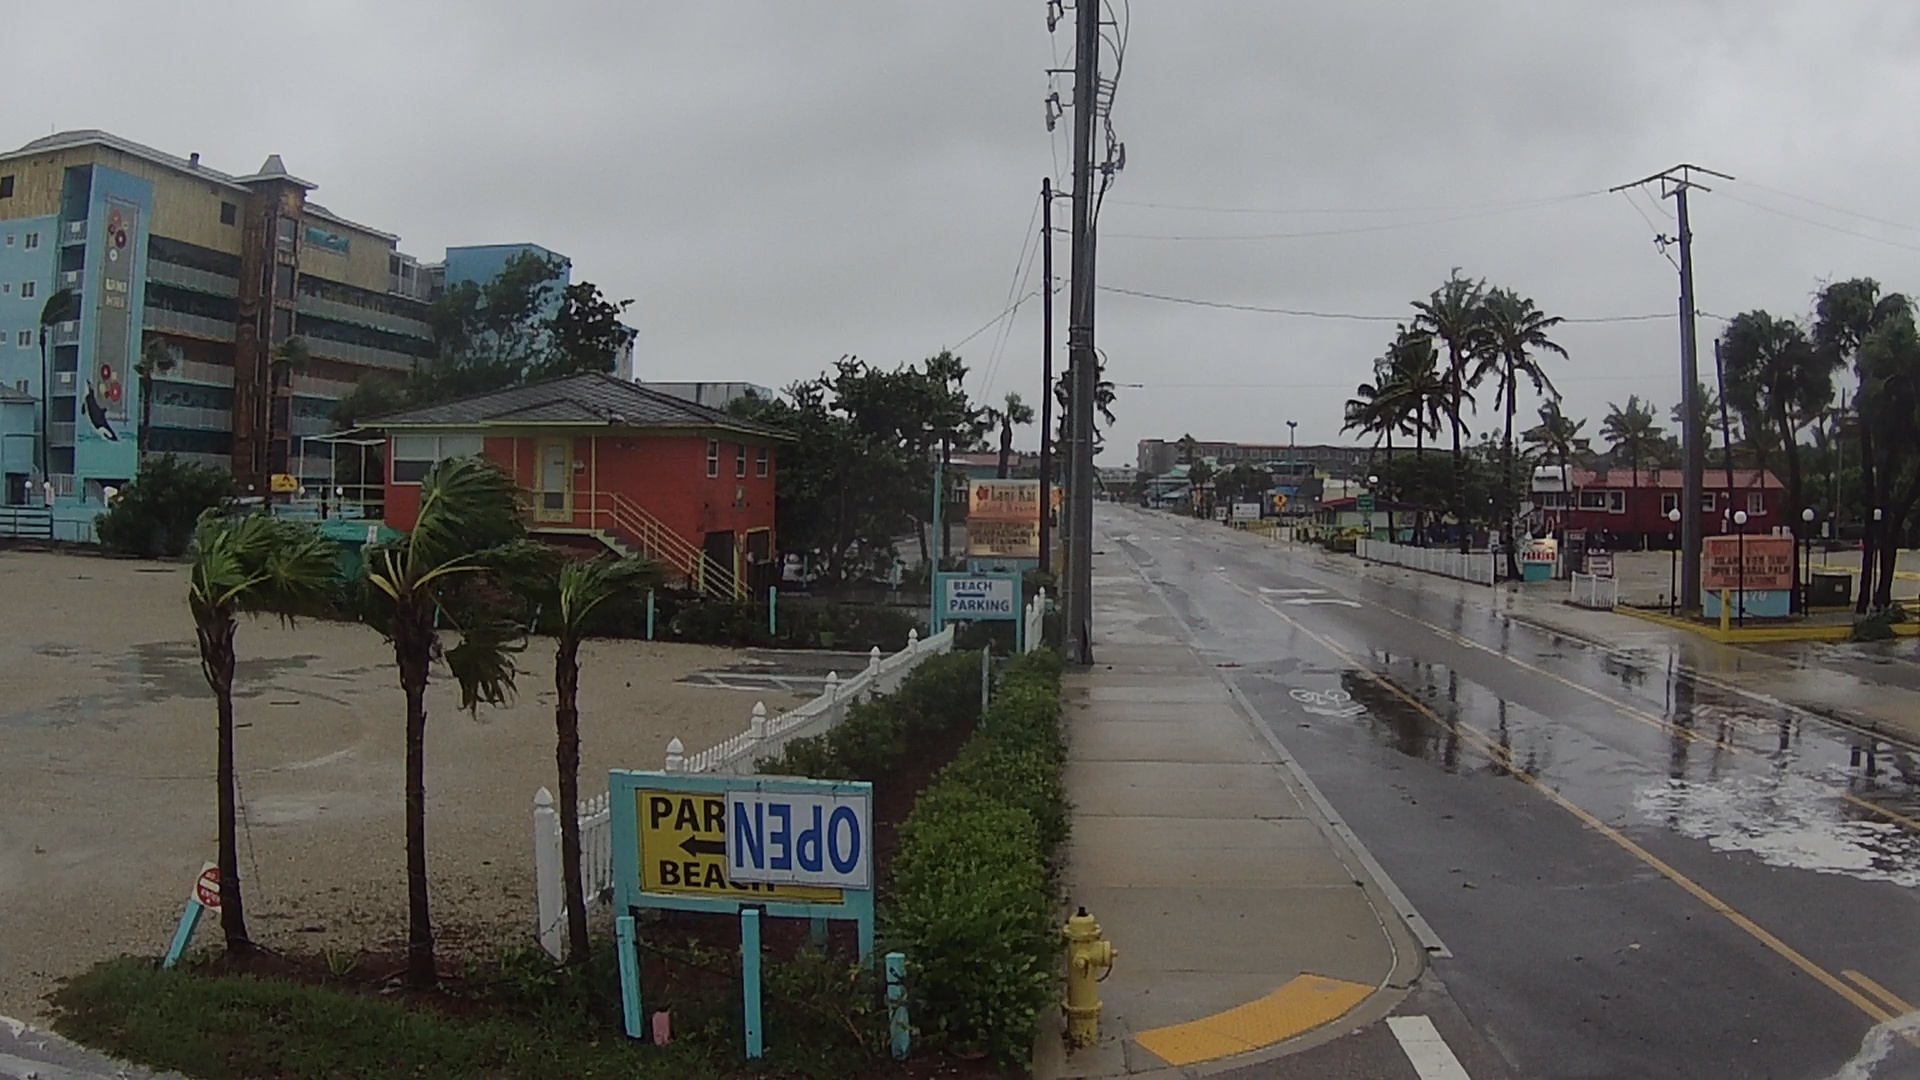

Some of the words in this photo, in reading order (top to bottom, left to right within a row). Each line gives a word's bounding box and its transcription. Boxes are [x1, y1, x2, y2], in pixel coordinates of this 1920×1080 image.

[953, 581, 993, 592] BEACH
[950, 599, 1010, 612] PARKING
[650, 796, 726, 832] PAR
[734, 801, 861, 874] OPEN
[659, 859, 775, 892] BEA
